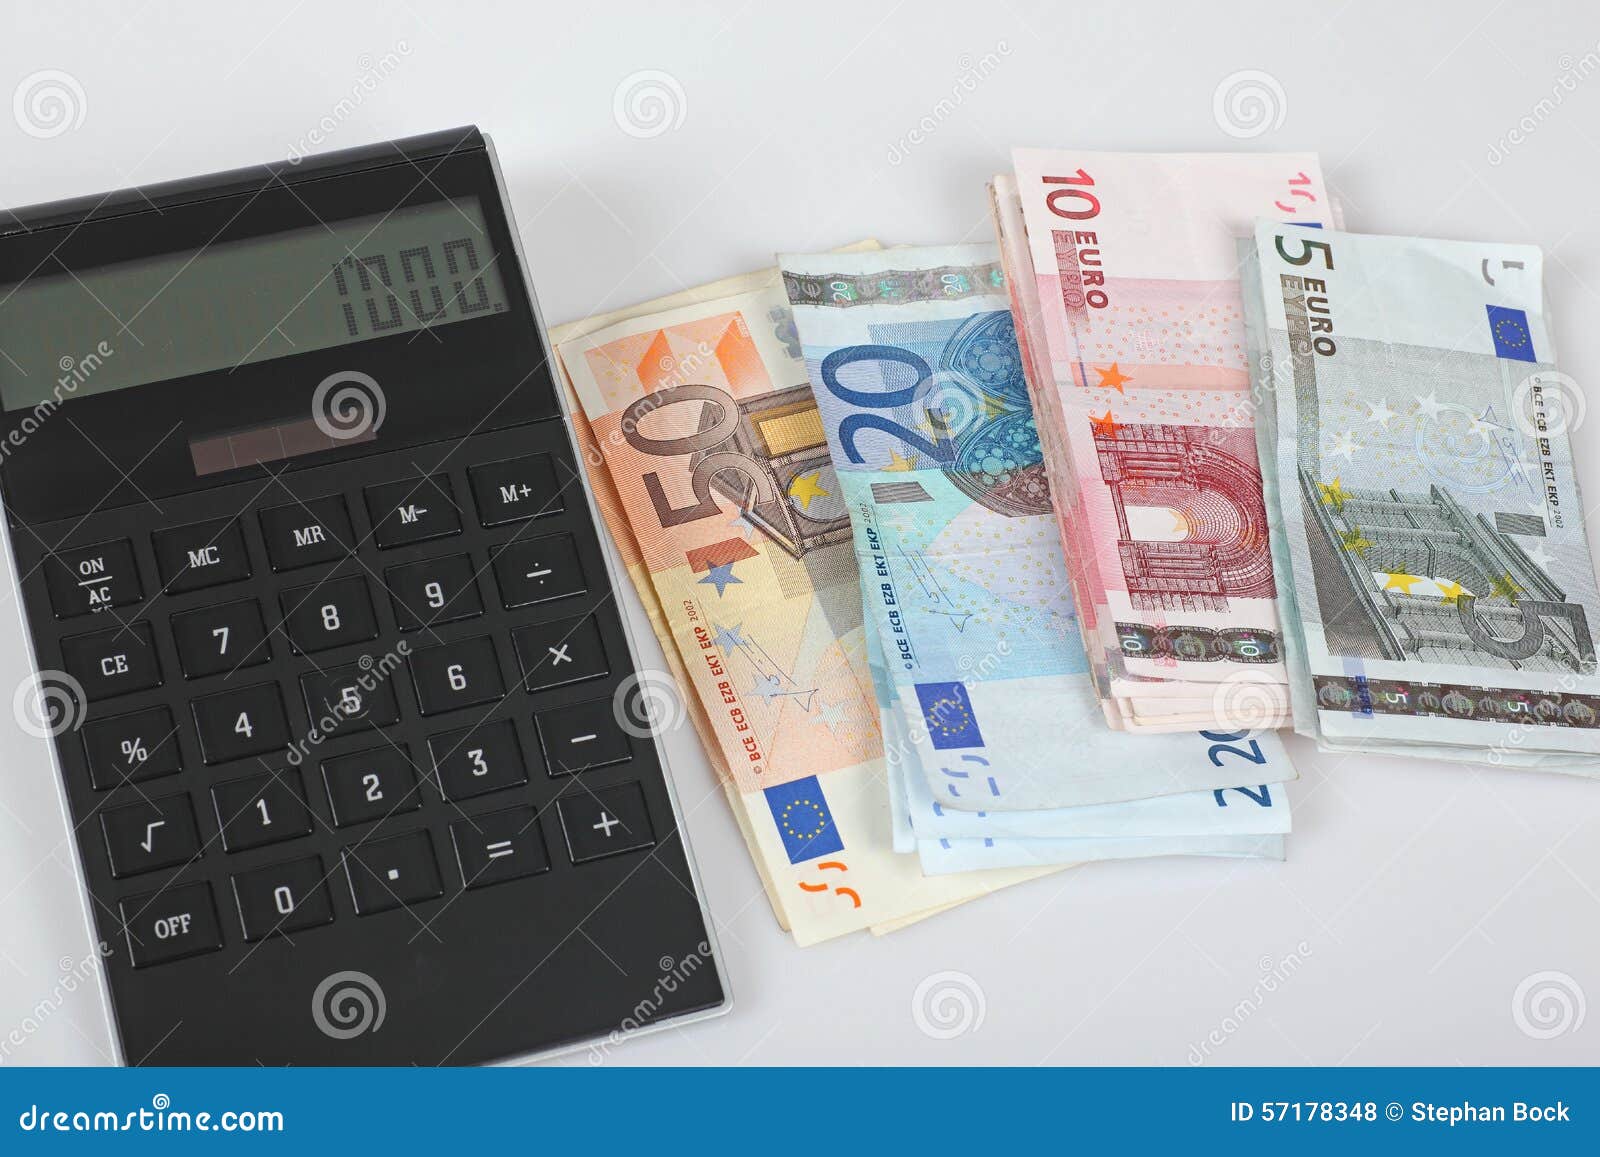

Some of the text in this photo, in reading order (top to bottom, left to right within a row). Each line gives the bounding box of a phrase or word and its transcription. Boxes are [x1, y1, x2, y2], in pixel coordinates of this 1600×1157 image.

[1042, 168, 1101, 220] 10
[1275, 235, 1335, 271] 5
[1074, 230, 1109, 310] EURO
[830, 281, 852, 301] 20
[940, 273, 963, 296] 20
[1303, 277, 1337, 357] EURO
[821, 344, 957, 464] 20
[1533, 386, 1544, 407] BCE
[1536, 412, 1547, 432] ECB
[621, 384, 776, 528] 50
[1539, 437, 1551, 456] EZB
[1543, 461, 1555, 481] EKT
[500, 484, 532, 504] M+
[1547, 485, 1559, 506] EKP
[859, 502, 872, 524] 2002
[1553, 510, 1564, 529] 2002
[293, 524, 326, 547] MR
[866, 527, 881, 550] EKP
[80, 557, 104, 574] ON
[188, 547, 220, 568] MC
[873, 554, 888, 576] EKT
[89, 587, 111, 604] AC
[425, 582, 444, 608] 9
[881, 583, 896, 605] EZB
[321, 605, 340, 631] 8
[683, 599, 699, 622] 2002
[888, 610, 904, 633] ECB
[212, 627, 229, 654] 7
[694, 626, 713, 650] EKP
[1457, 594, 1598, 664] 5
[897, 639, 913, 661] BCE
[1122, 633, 1142, 651] 10
[1239, 638, 1260, 657] 10
[100, 655, 129, 677] CE
[705, 654, 724, 676] EKT
[447, 664, 467, 691] 6
[342, 687, 361, 713] 5
[718, 681, 735, 704] EZB
[1386, 692, 1408, 706] 5
[1507, 701, 1528, 713] 5
[234, 712, 252, 737] 4
[730, 707, 748, 732] ECB
[121, 737, 148, 764] %
[742, 736, 761, 762] BCE
[468, 749, 488, 776] 3
[362, 773, 383, 801] 2
[256, 798, 271, 825] 1
[274, 886, 294, 914] 0
[154, 913, 191, 939] OFF
